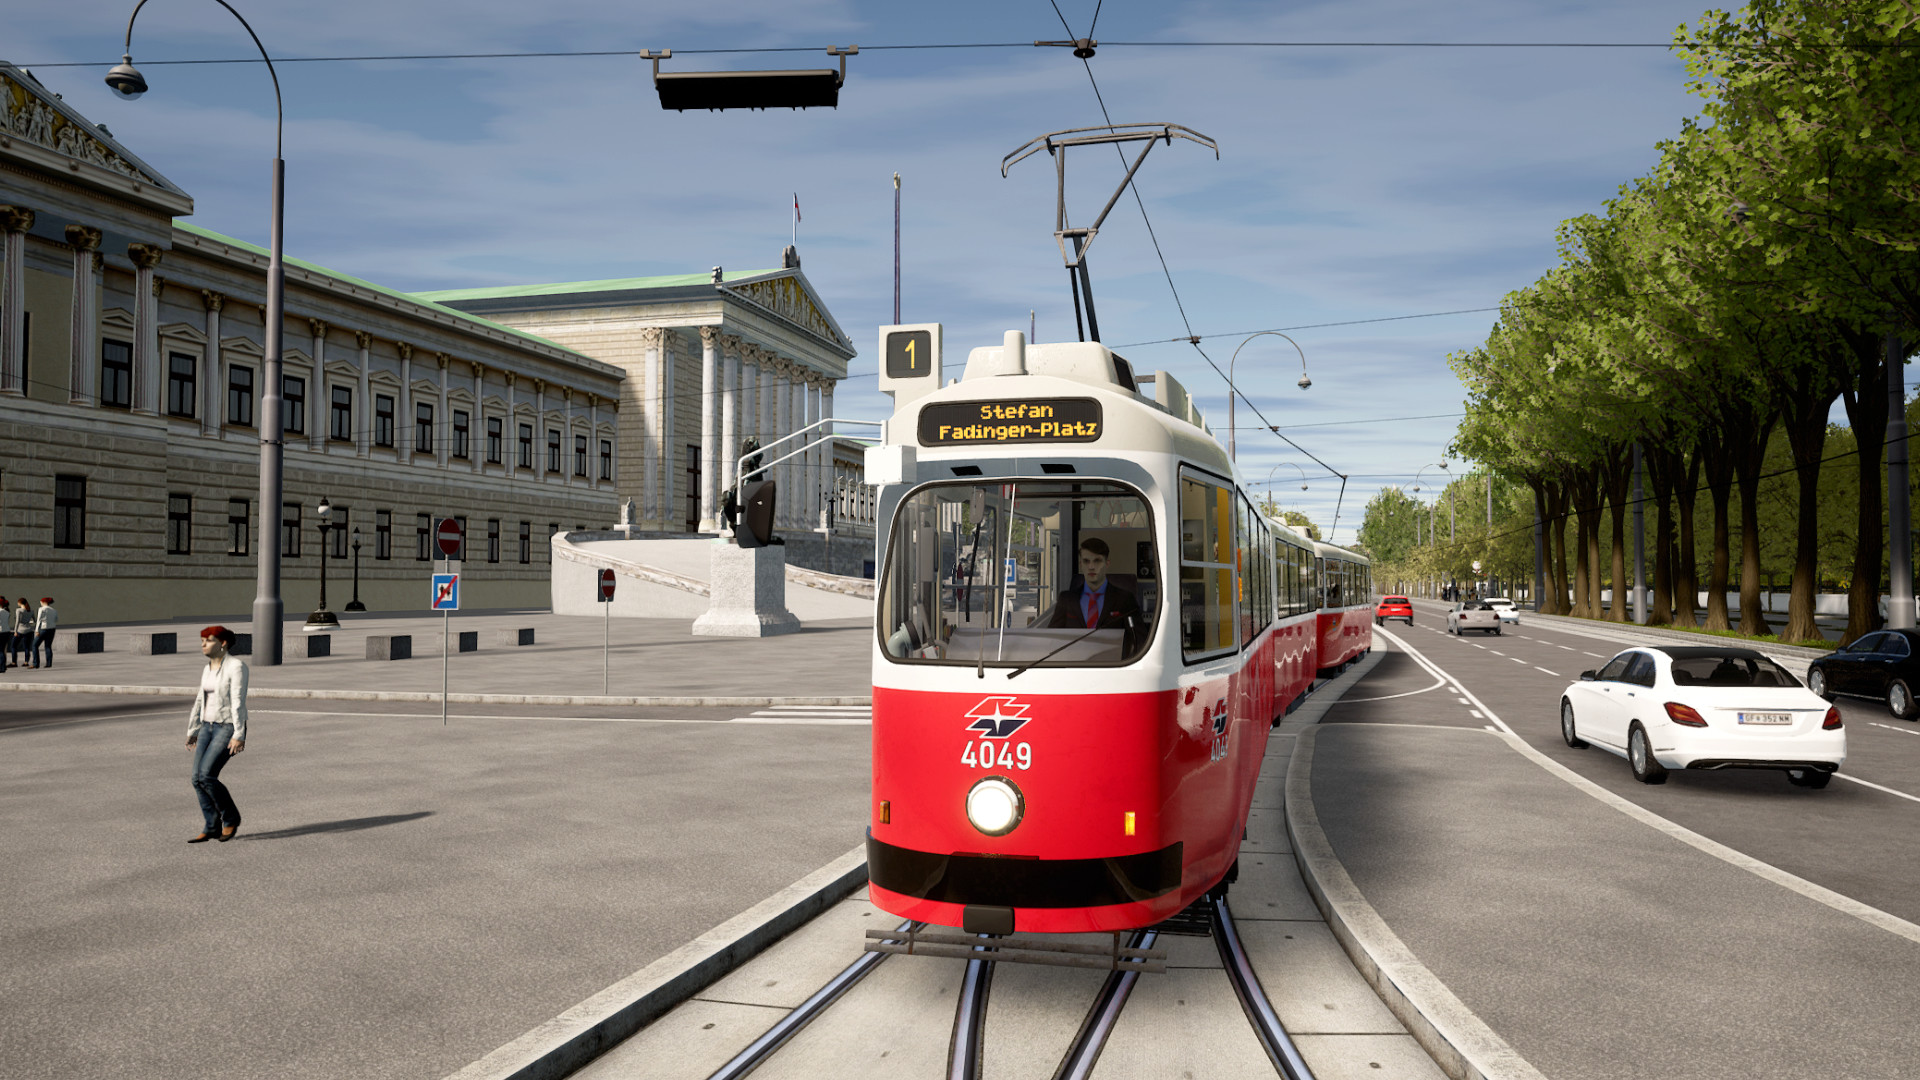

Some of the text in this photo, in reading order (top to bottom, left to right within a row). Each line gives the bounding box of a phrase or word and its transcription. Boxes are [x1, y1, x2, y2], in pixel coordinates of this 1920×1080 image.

[904, 339, 915, 369] 1
[980, 404, 1053, 420] Stefan
[938, 421, 1097, 440] Fadinger-Platz
[960, 740, 1031, 770] 4049
